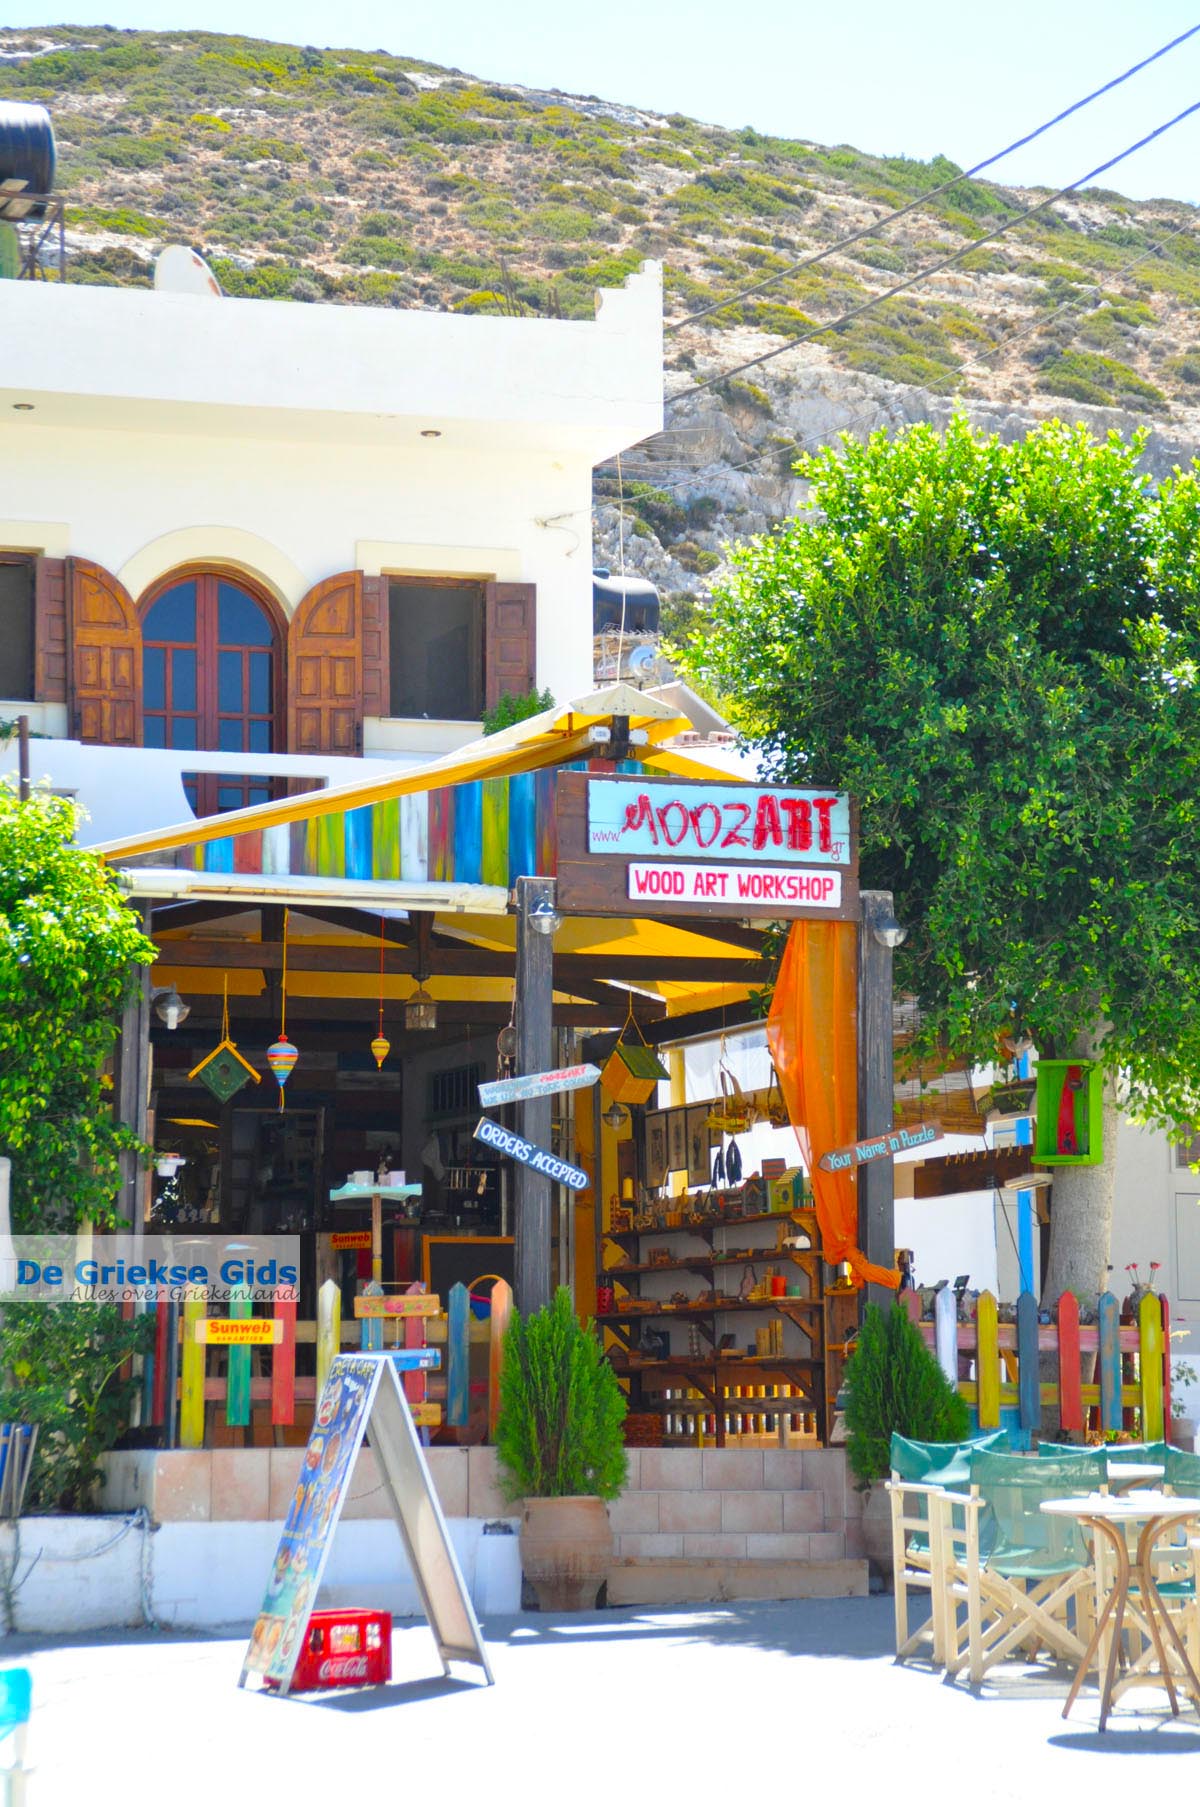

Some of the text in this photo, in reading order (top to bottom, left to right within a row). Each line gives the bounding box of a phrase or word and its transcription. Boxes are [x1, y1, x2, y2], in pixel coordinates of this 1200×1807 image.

[635, 869, 834, 901] WOOD ART WORKSHOP
[480, 1123, 587, 1189] ORDERS ACCEPTED
[828, 1124, 935, 1170] Your Name in Puzzle
[210, 1321, 271, 1334] Sunweb
